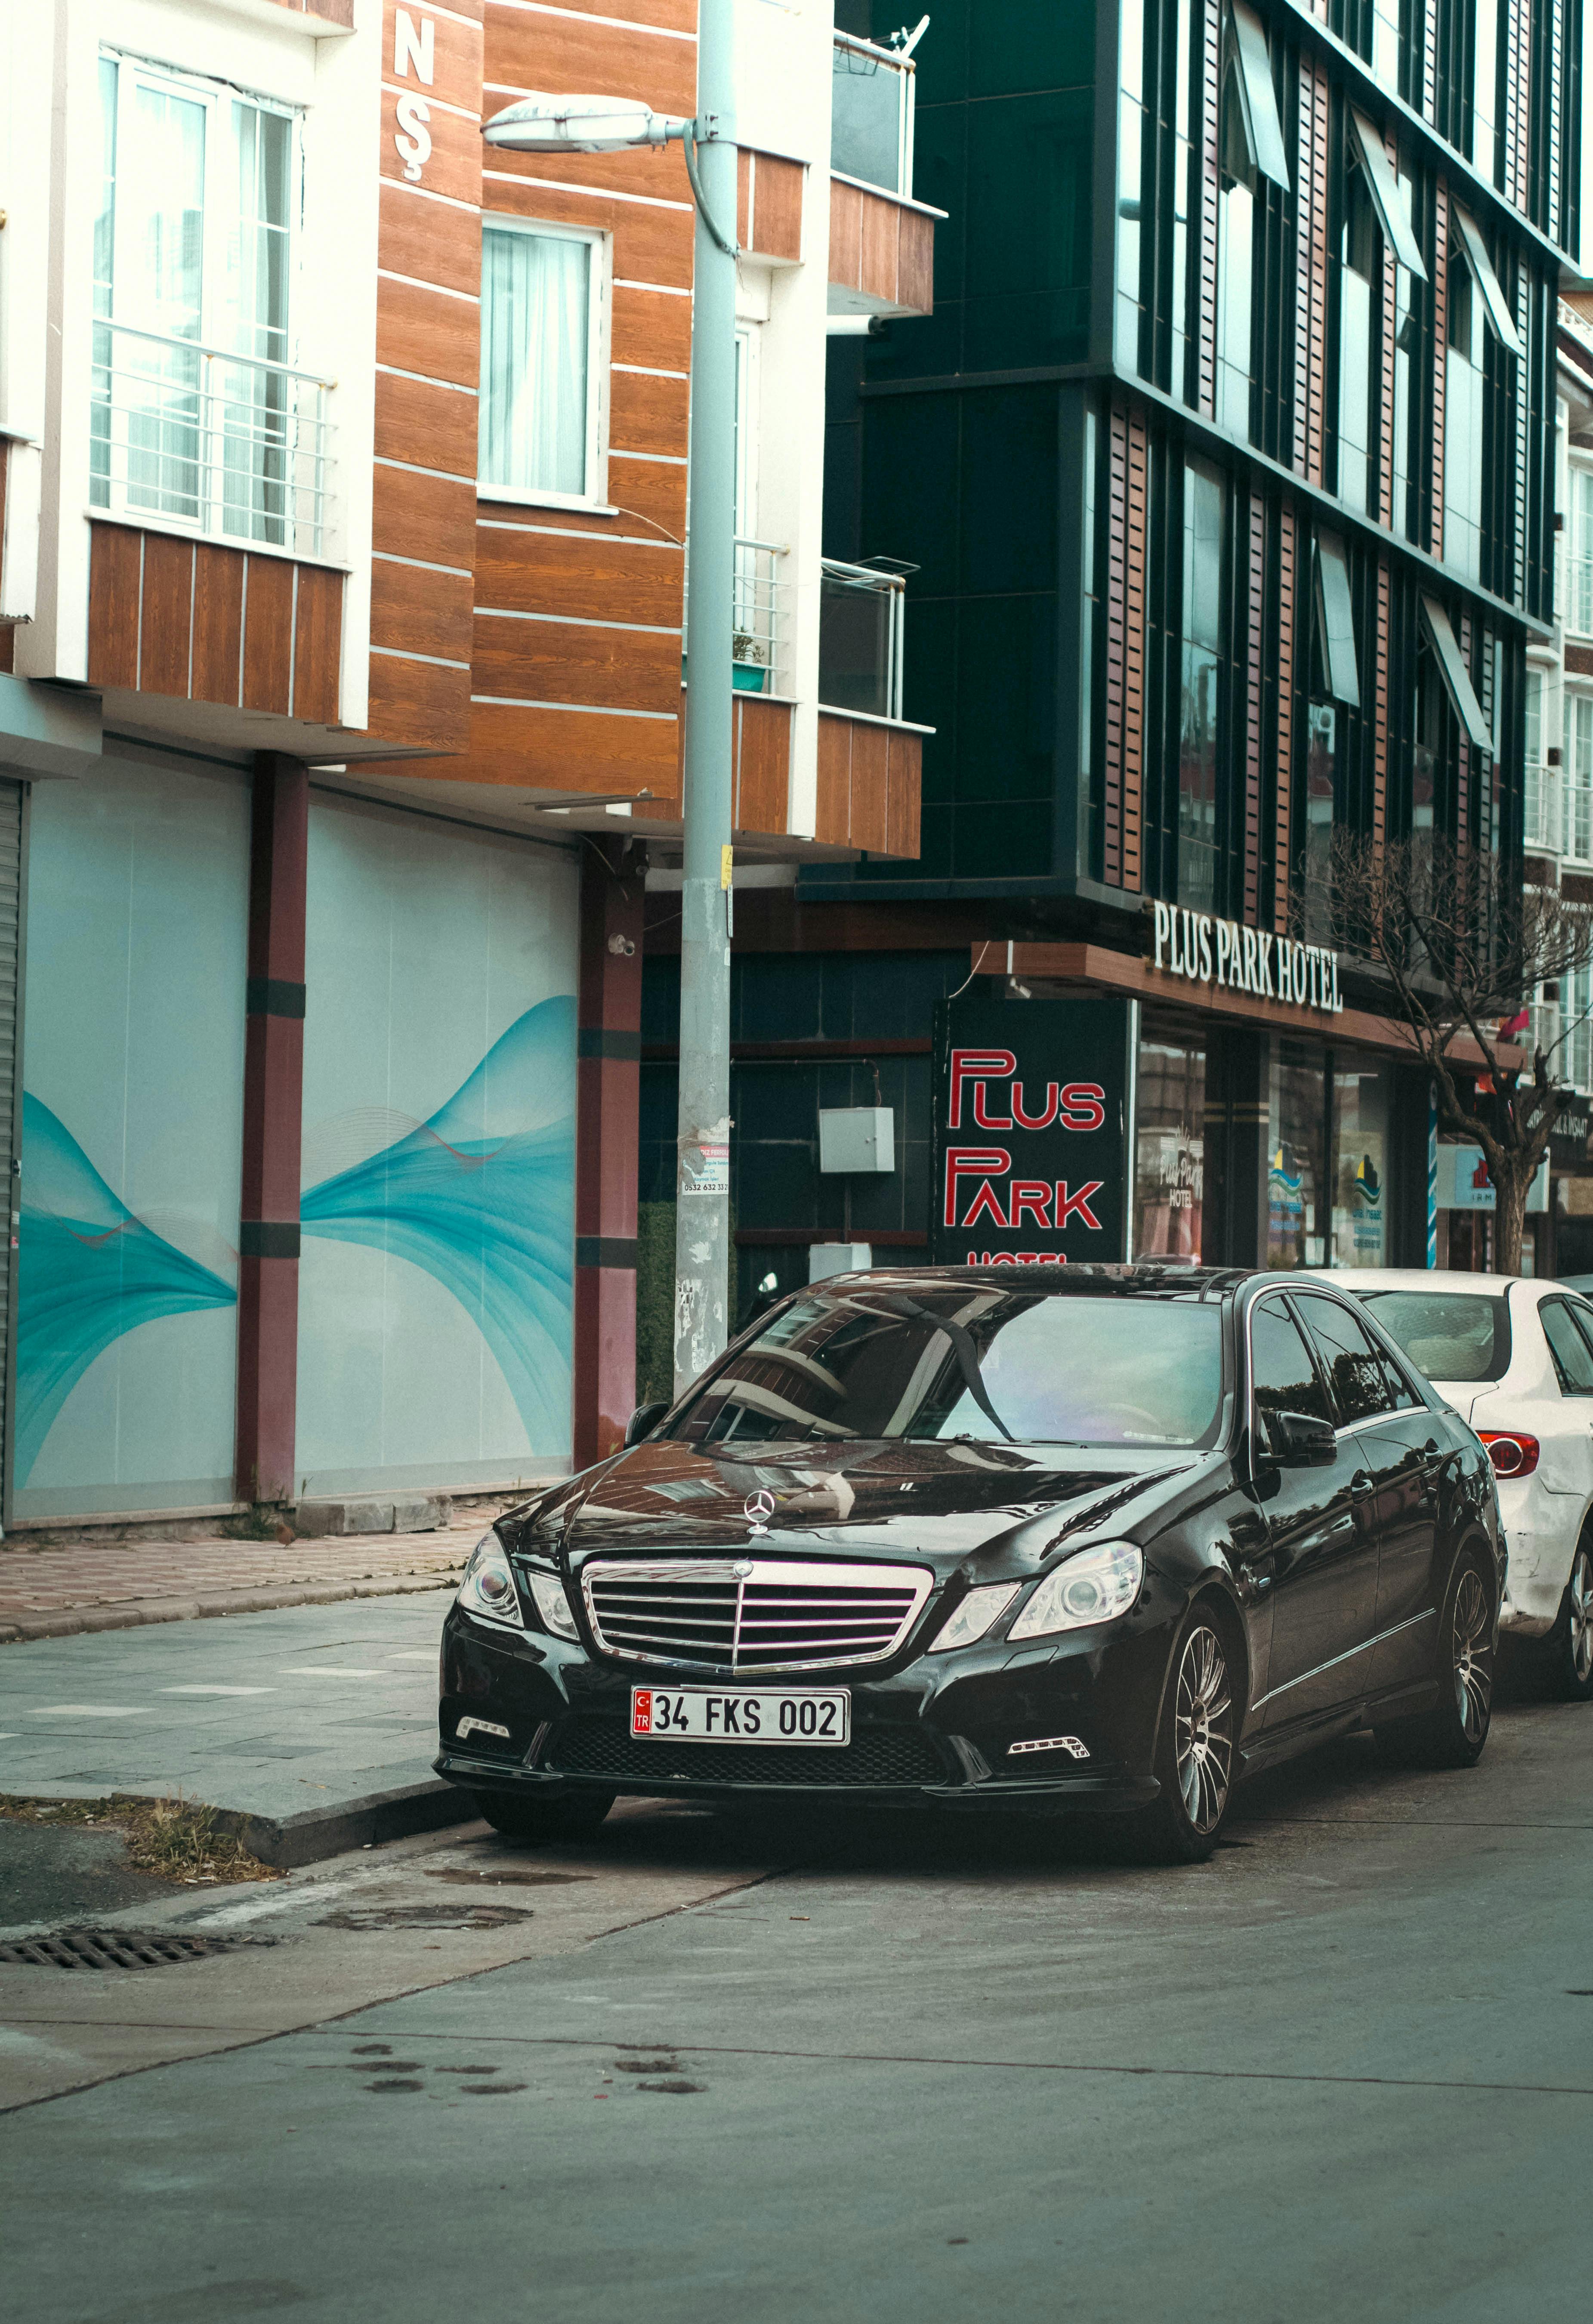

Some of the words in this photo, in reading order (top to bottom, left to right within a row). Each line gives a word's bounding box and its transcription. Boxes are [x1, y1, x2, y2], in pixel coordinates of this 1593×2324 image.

[1154, 900, 1212, 982] PLUS
[1216, 918, 1275, 998] PARK
[1276, 936, 1343, 1013] HOTEL
[949, 1049, 1105, 1131] PLUS
[944, 1147, 1105, 1229] PARK
[1170, 1189, 1192, 1208] HOTEL
[636, 1714, 649, 1728] TR
[654, 1695, 689, 1731] 34
[706, 1697, 761, 1734] FKS
[779, 1700, 837, 1736] 002
